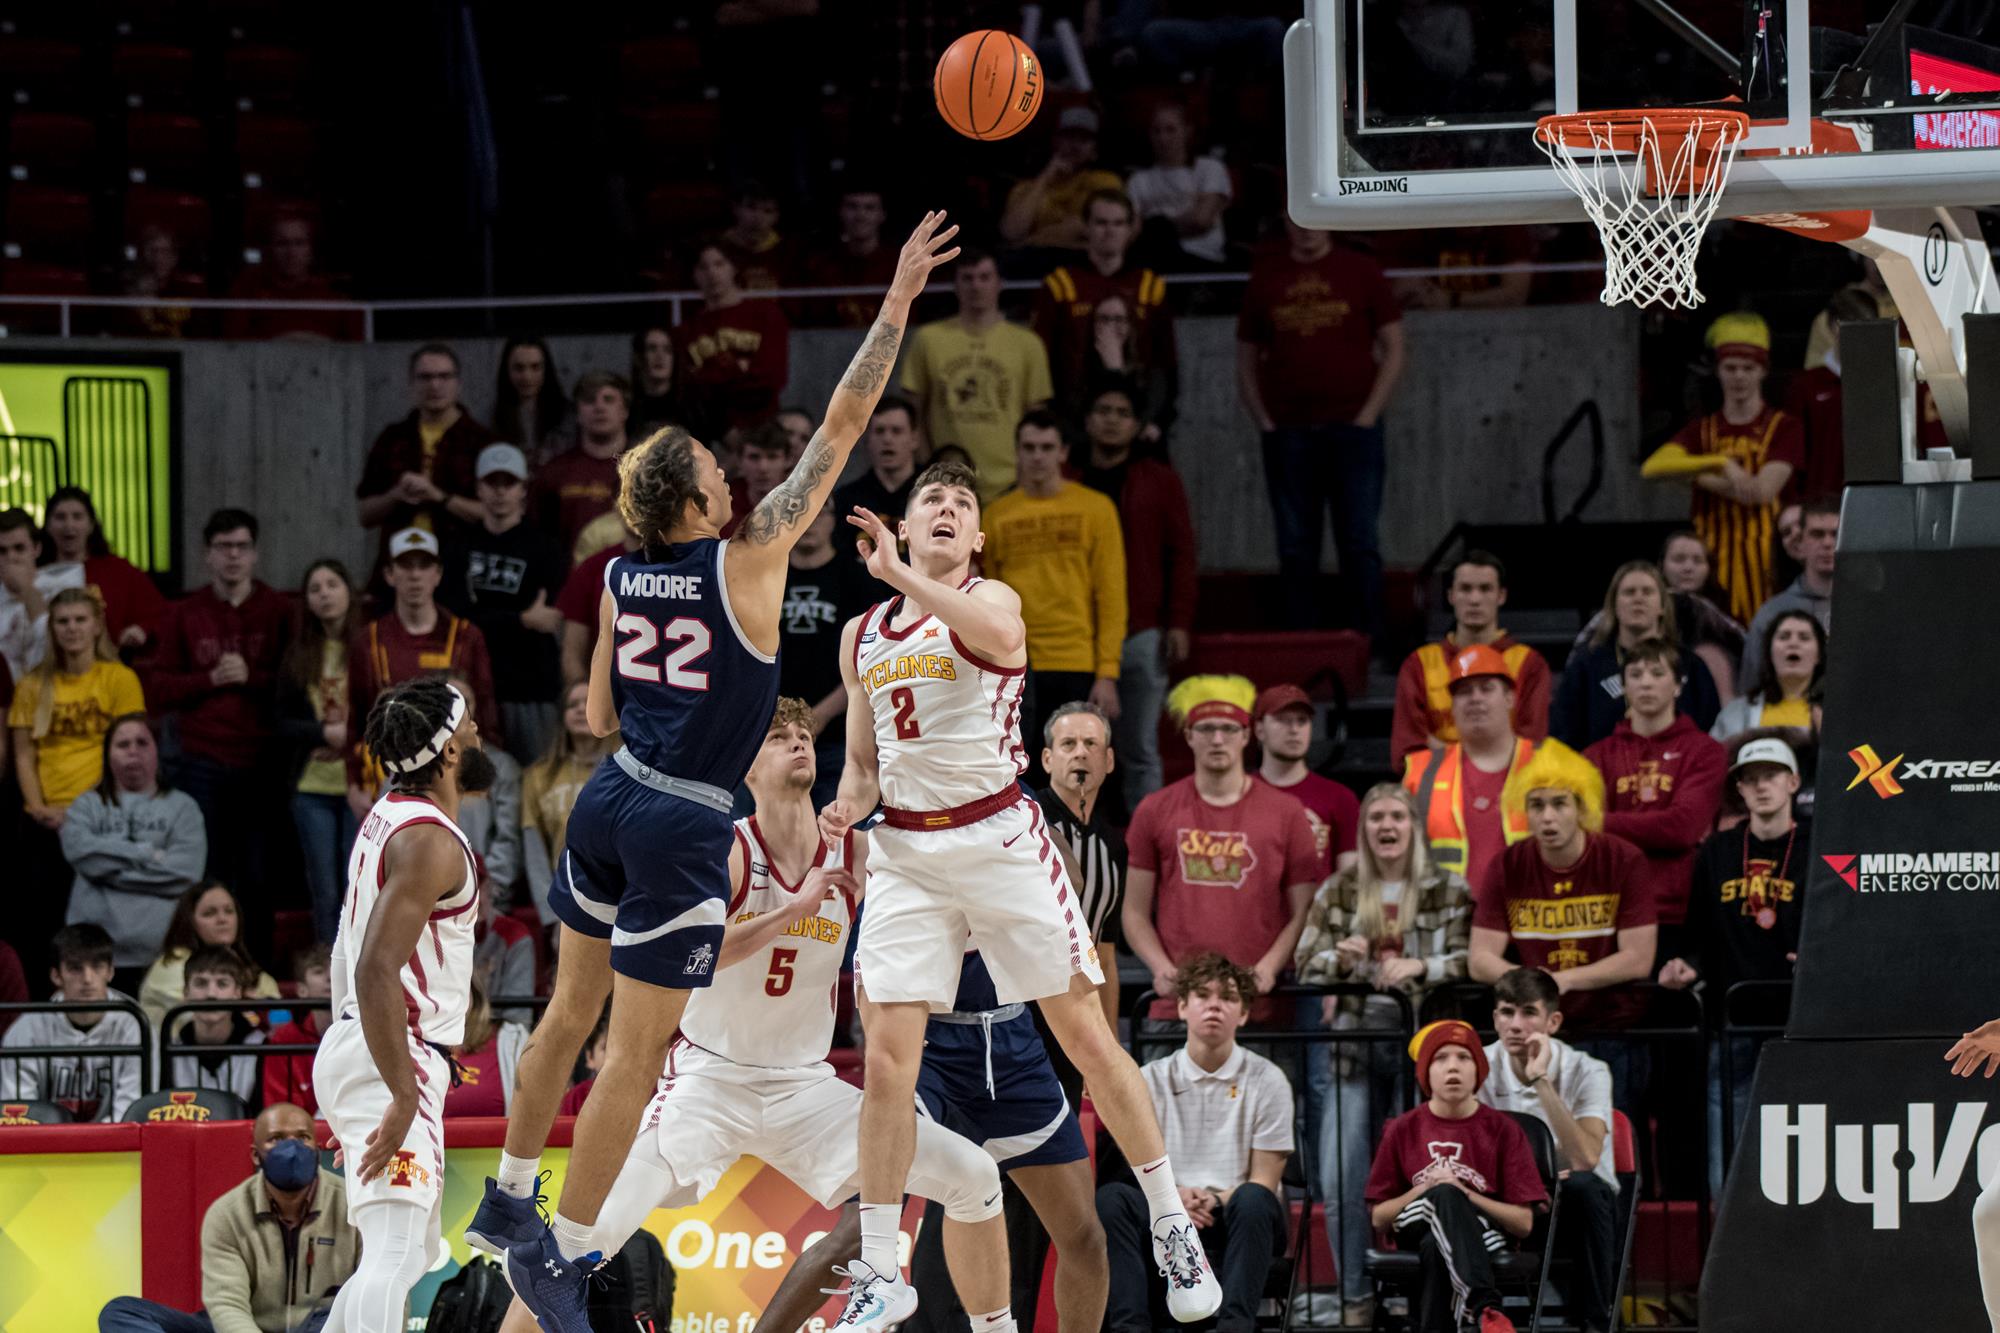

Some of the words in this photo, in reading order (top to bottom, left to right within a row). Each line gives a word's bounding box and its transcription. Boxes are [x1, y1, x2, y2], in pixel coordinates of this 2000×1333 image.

[1339, 177, 1408, 197] SPALDING
[620, 572, 702, 600] MOORE
[783, 600, 837, 625] TATE
[616, 611, 713, 692] 22
[861, 654, 957, 696] YCLONES
[891, 687, 921, 741] 2
[1860, 852, 2000, 874] MIDAMERI
[1721, 875, 1796, 903] STATE
[1860, 874, 1941, 893] ENERGY
[1518, 900, 1611, 928] CYCLONES
[765, 947, 798, 997] 5
[666, 1219, 787, 1269] One
